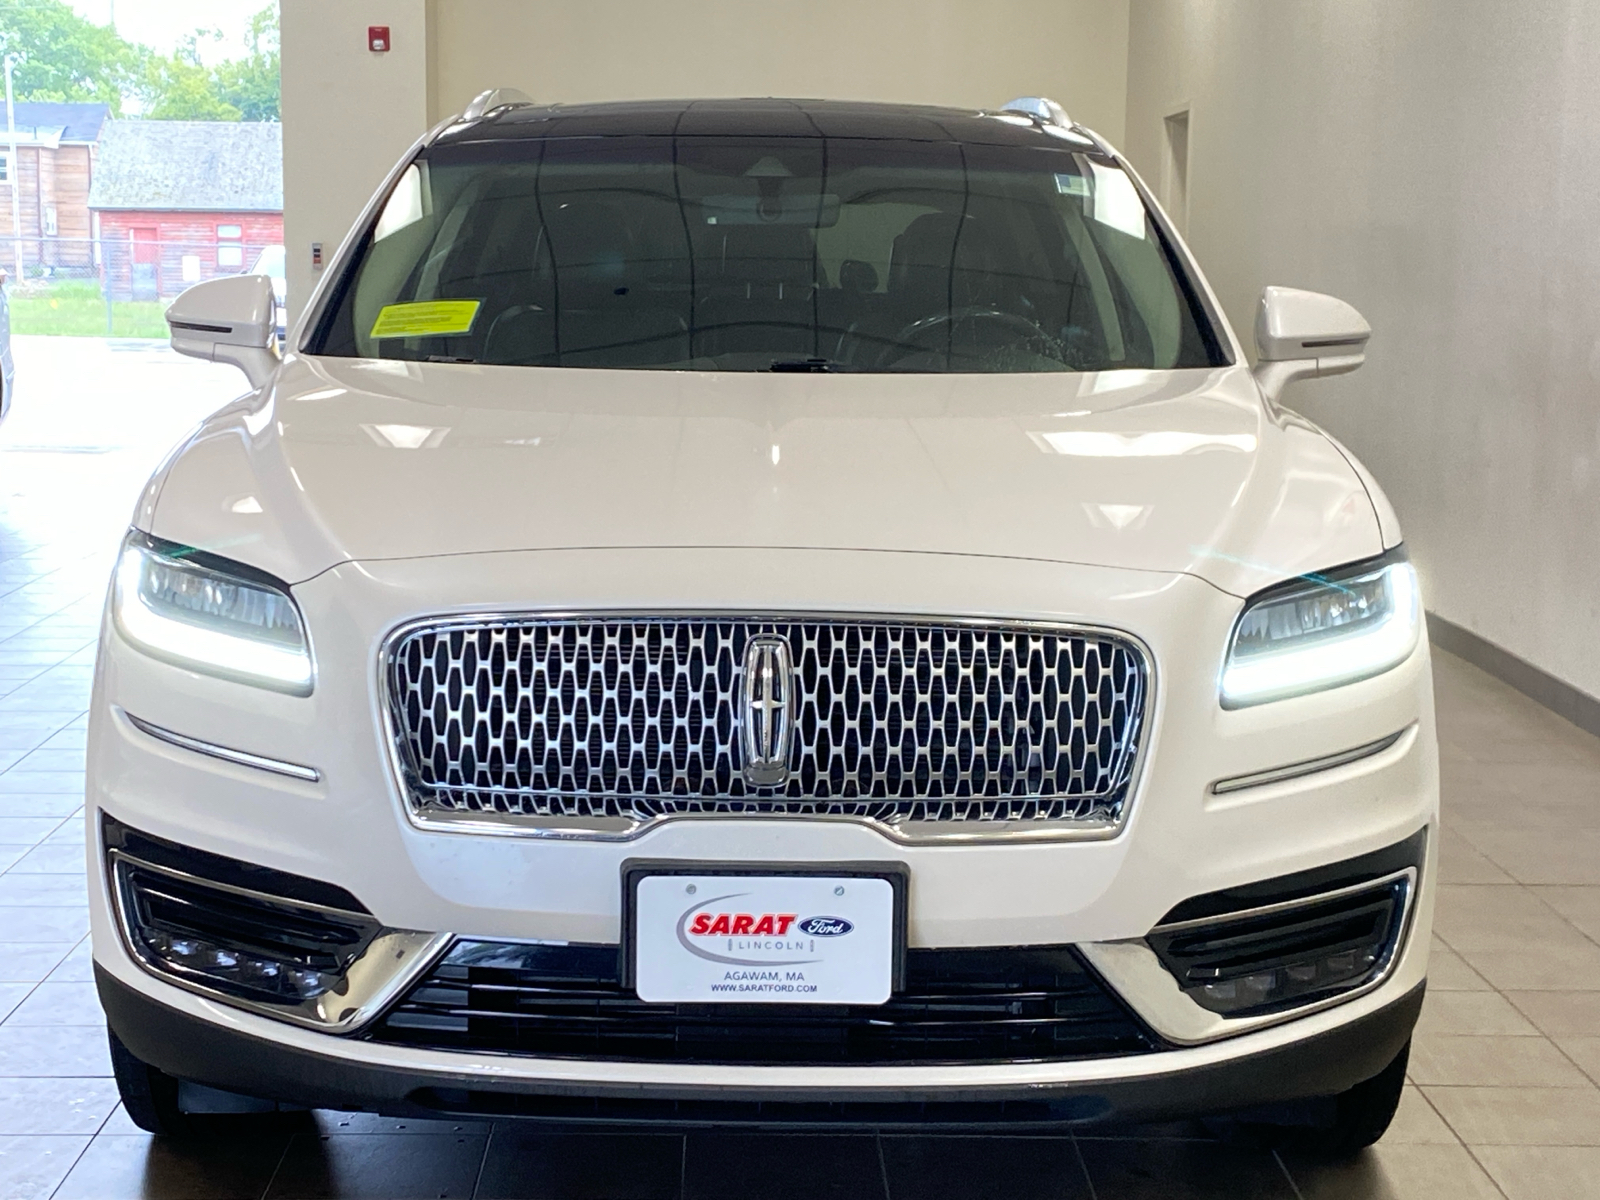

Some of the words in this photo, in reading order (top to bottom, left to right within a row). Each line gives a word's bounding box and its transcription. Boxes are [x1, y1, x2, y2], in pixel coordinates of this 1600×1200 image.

[689, 913, 798, 936] SARAT
[808, 919, 844, 935] Ford
[738, 940, 804, 950] LINCOLN
[724, 971, 783, 982] AGAWAM,
[785, 971, 805, 981] MA
[711, 984, 818, 993] WWW.SARATFORD.COM
